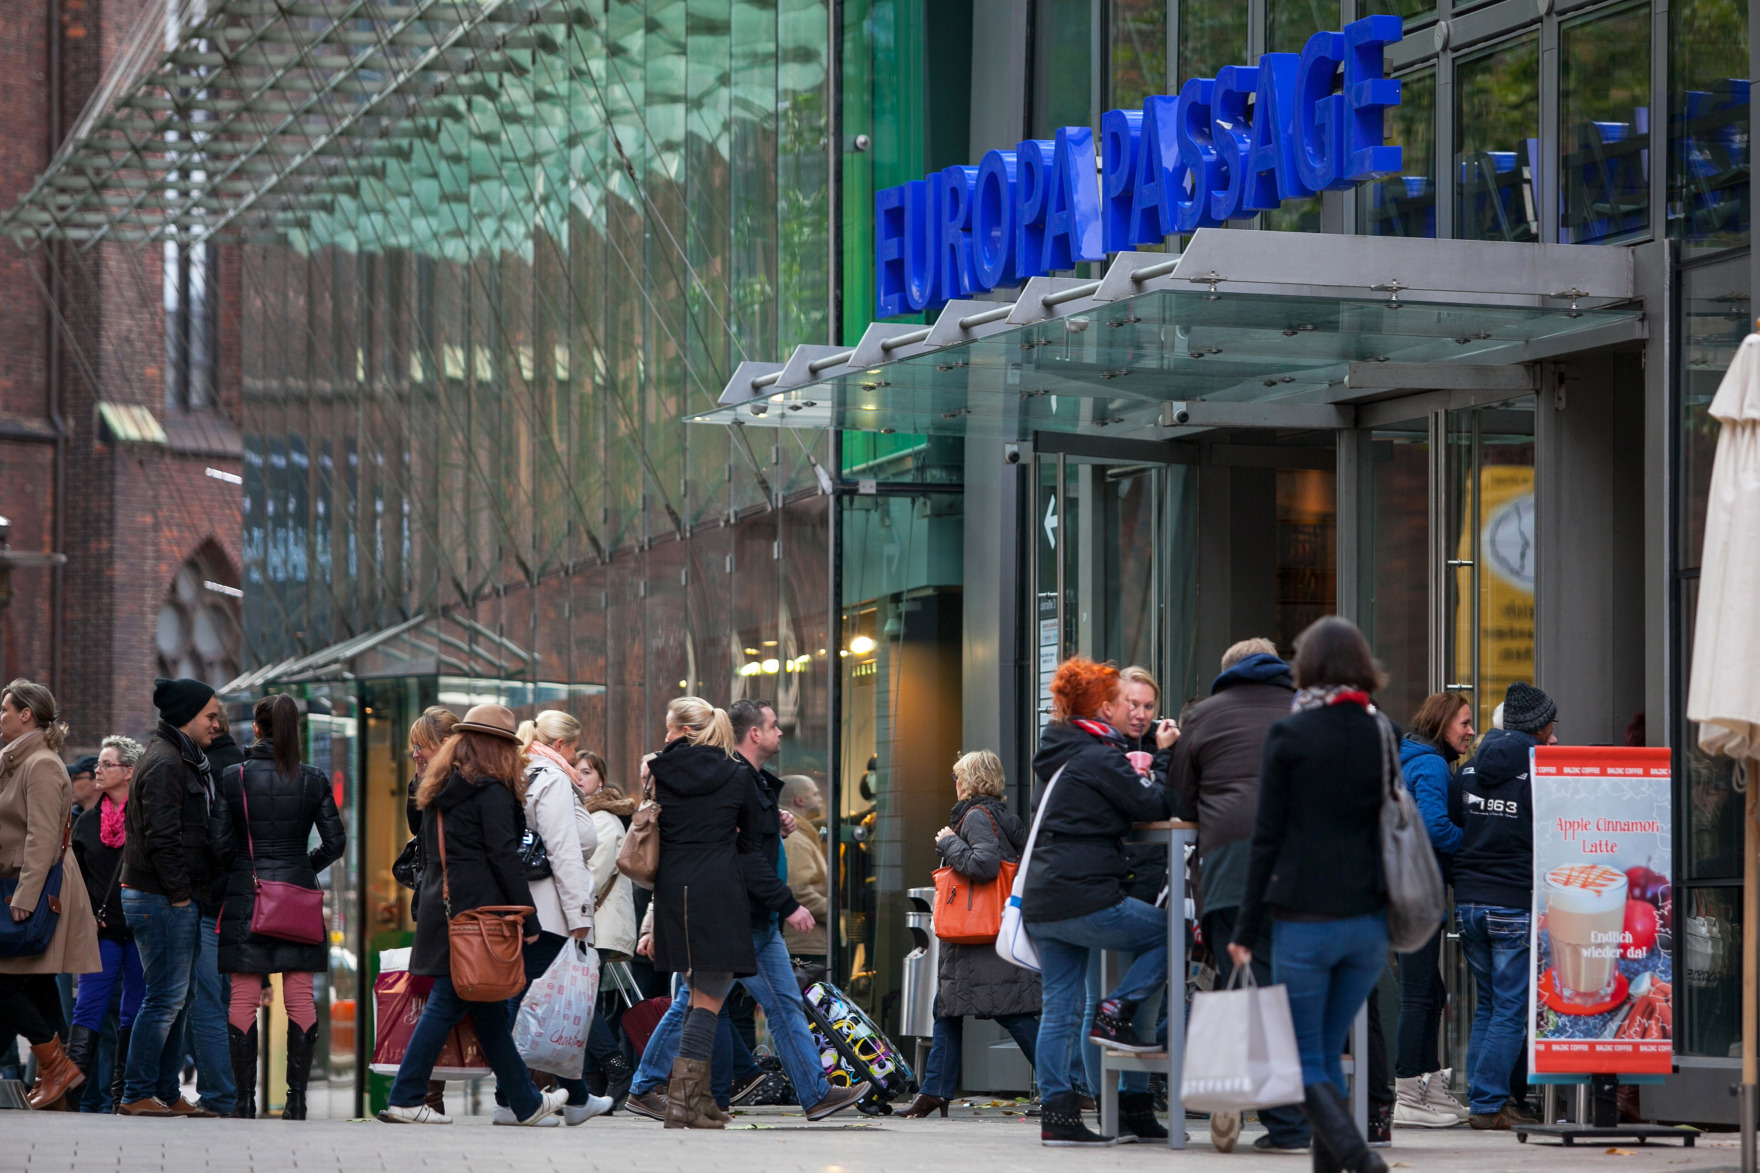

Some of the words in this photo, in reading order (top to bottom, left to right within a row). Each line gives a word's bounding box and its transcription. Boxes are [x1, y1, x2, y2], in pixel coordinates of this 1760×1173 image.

[876, 126, 1106, 318] EUROPA
[1102, 14, 1404, 254] PASSAGE
[1625, 767, 1643, 775] COFFEE
[1477, 799, 1517, 814] 1963
[1555, 817, 1591, 841] Apple
[1596, 817, 1660, 832] Cinnamon
[1582, 839, 1618, 853] Latte
[1590, 931, 1633, 944] Endlich
[1582, 946, 1623, 959] wieder
[1627, 946, 1647, 959] da!
[1614, 1044, 1633, 1052] COFFEE
